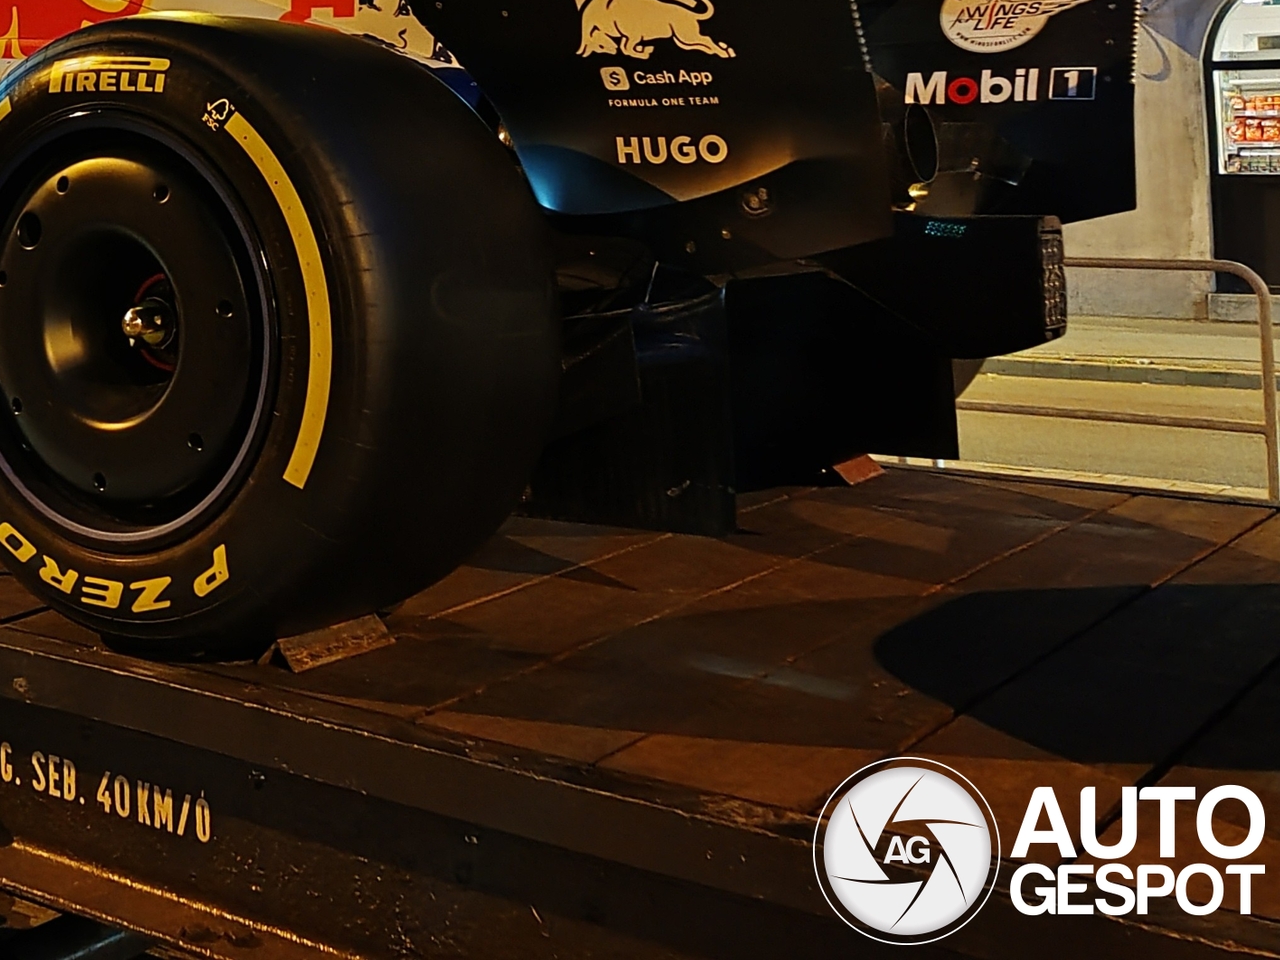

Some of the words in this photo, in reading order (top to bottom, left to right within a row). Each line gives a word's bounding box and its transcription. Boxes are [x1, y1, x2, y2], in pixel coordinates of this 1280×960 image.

[48, 55, 170, 93] PIRELLI
[633, 70, 676, 84] Cash
[678, 69, 713, 86] App
[904, 68, 1039, 105] Mobil
[608, 98, 659, 107] FORMULA
[661, 97, 686, 106] ONE
[688, 96, 719, 105] TEAM
[201, 113, 220, 132] FSC
[615, 135, 728, 165] HUGO
[193, 543, 230, 597] P
[31, 750, 85, 805] SEB.
